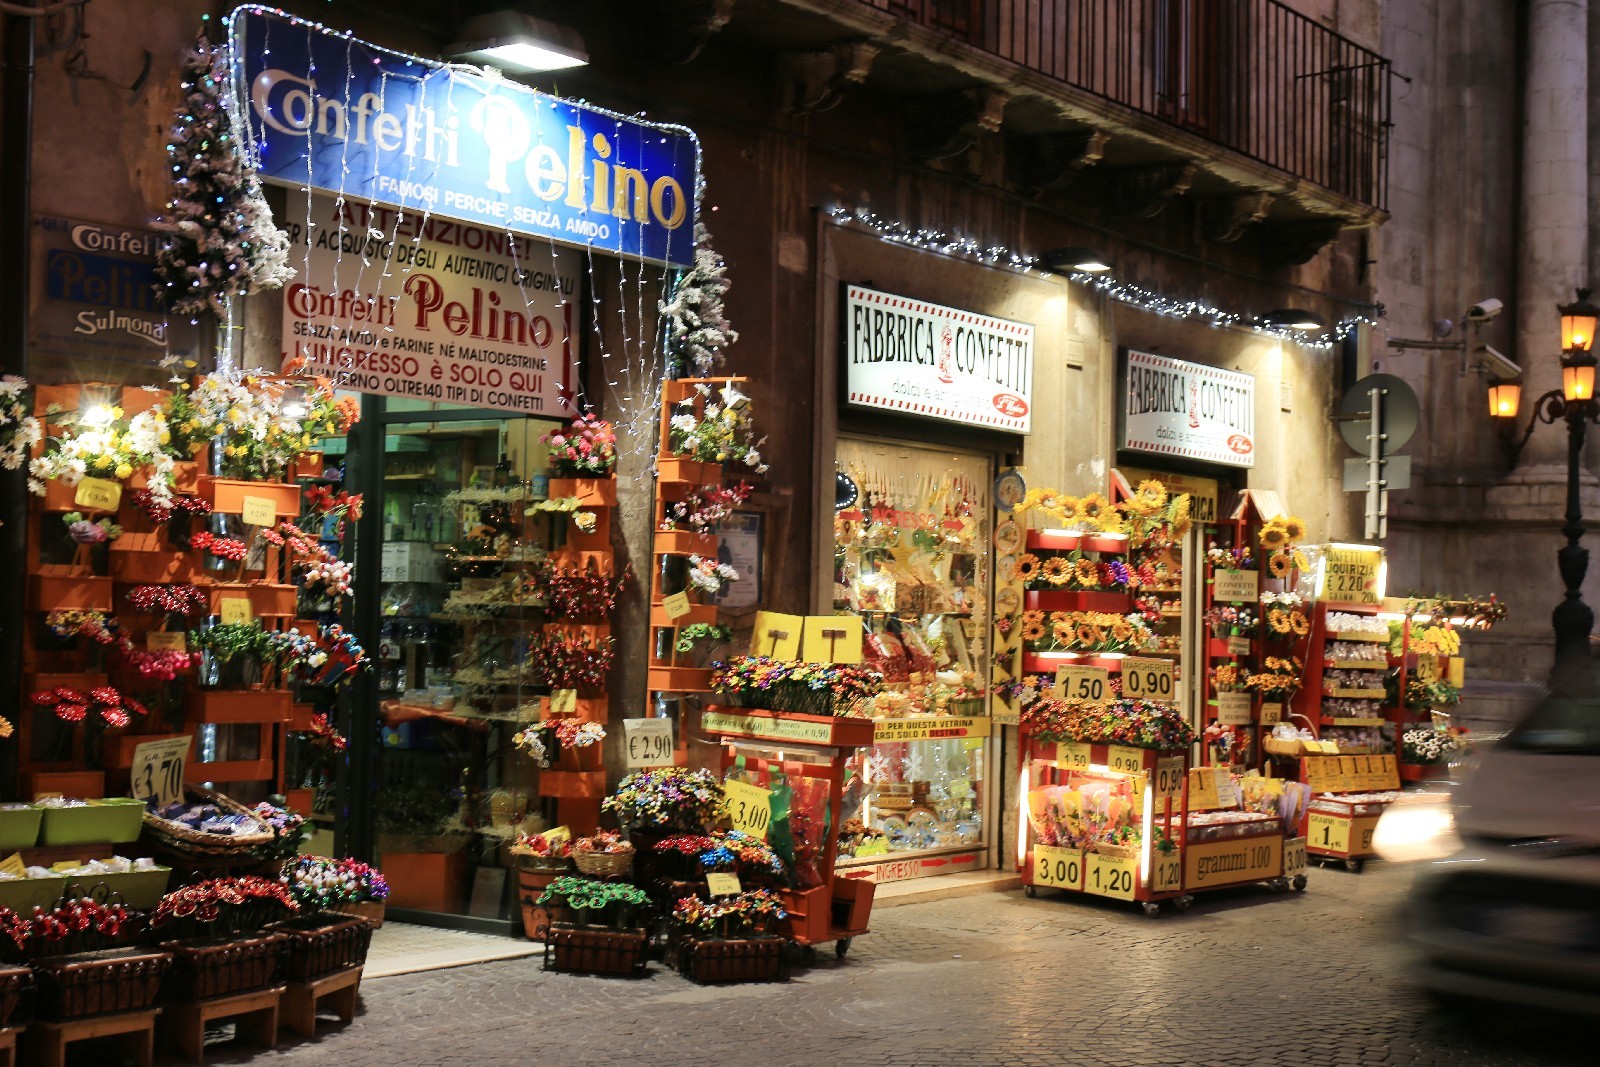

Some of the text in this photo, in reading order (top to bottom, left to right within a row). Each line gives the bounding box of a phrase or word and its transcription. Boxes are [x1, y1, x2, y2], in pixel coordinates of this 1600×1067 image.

[252, 69, 687, 230] Confetti Pelino
[379, 175, 438, 203] FAMOSI
[513, 205, 561, 230] SENZA
[565, 217, 610, 240] AMIDO
[332, 200, 530, 261] ATTENZIONE!
[396, 244, 438, 270] DEGLI
[443, 253, 509, 284] AUTENTICI
[74, 310, 168, 346] Sulmona
[286, 273, 554, 349] Confetti Pelino
[292, 321, 335, 340] SENZA
[393, 336, 434, 355] FARINE
[459, 345, 547, 371] MALTODESTRINE
[853, 304, 935, 366] FABBRICA
[450, 362, 502, 388] SOLO
[509, 371, 542, 394] QUI
[955, 326, 1029, 395] CONFETTI
[445, 385, 467, 401] TIPI
[471, 389, 483, 403] DI
[488, 391, 544, 411] CONFETTI
[892, 378, 920, 397] dolci
[1129, 365, 1186, 416] FABBRICA
[1201, 380, 1251, 435] CONFETTI
[1123, 660, 1172, 673] MARGHERITE
[887, 722, 904, 730] PER
[906, 721, 937, 730] QUESTA
[940, 719, 974, 728] VETRINA
[897, 730, 919, 739] SOLO
[642, 735, 671, 764] 2,90
[734, 801, 768, 831] 3,00
[876, 860, 920, 881] INGRESSO
[1040, 857, 1078, 886] 3,00
[1092, 866, 1132, 893] 1,20
[1197, 845, 1271, 881] grammi 100
